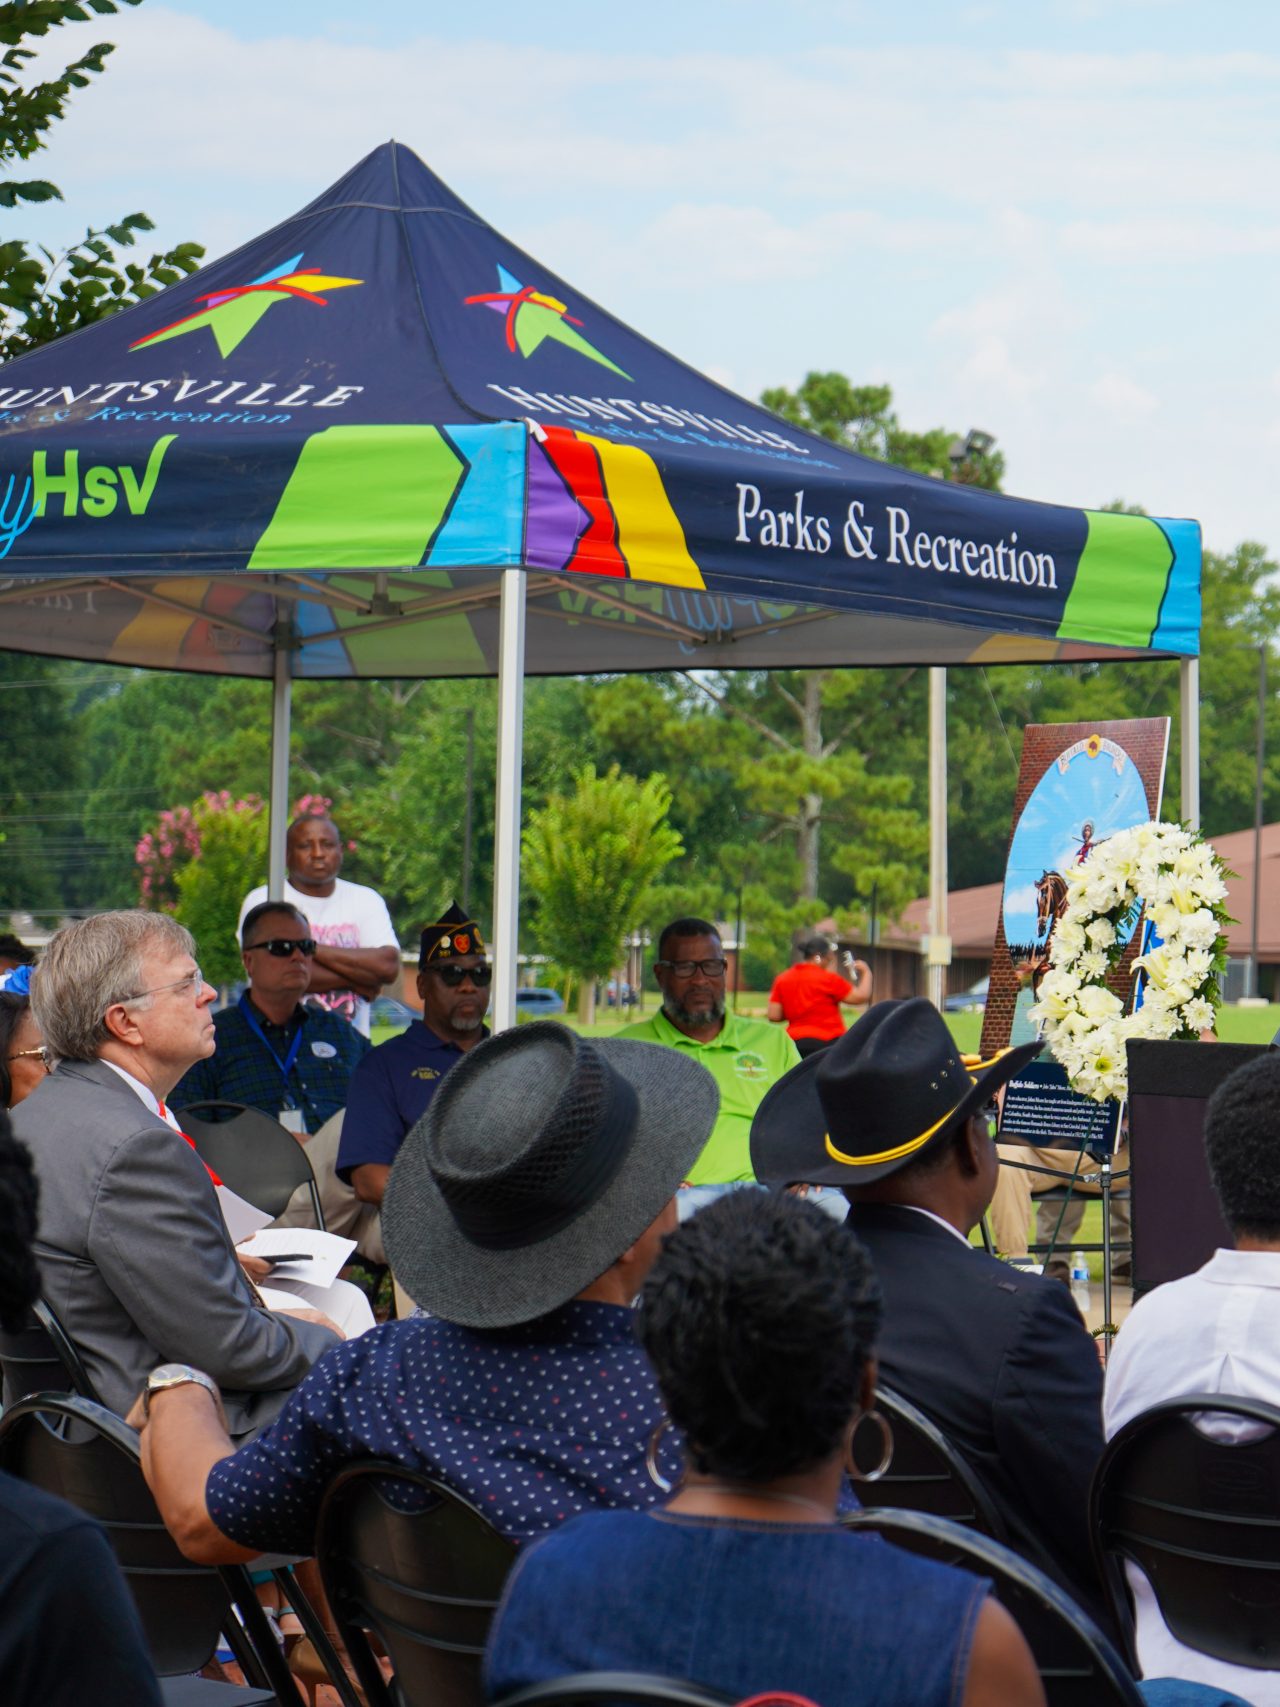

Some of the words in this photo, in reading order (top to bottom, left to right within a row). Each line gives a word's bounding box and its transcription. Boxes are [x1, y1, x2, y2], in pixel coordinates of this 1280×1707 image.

[0, 379, 365, 408] UNTSVILLE
[88, 406, 293, 425] Recreation
[486, 383, 811, 455] HUNTSVILLE
[735, 482, 832, 554] Parks
[843, 500, 879, 560] &
[885, 505, 1058, 590] Recreation
